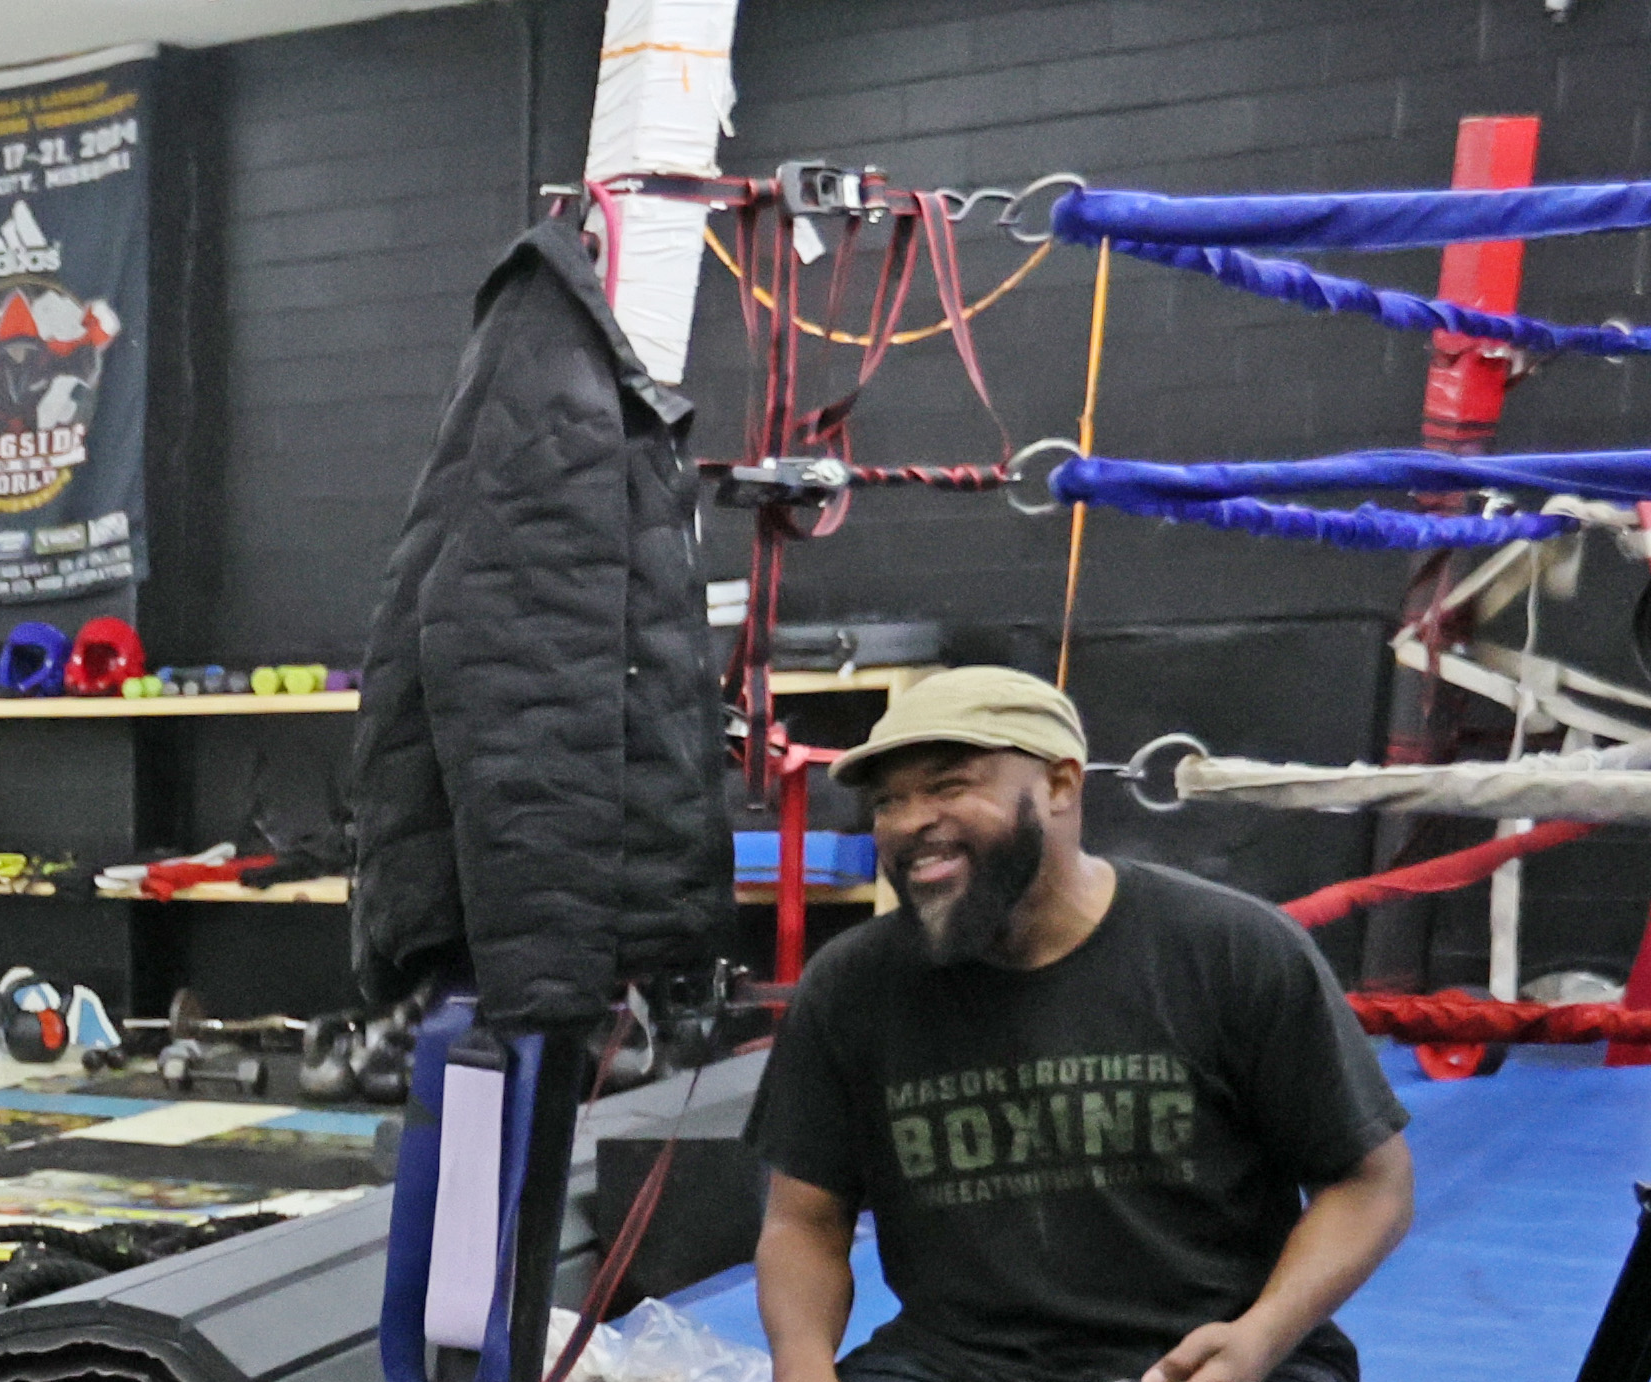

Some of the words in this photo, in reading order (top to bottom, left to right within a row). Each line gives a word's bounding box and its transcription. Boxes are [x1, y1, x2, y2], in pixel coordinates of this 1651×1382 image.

[887, 1068, 1008, 1110] MASON
[1017, 1054, 1189, 1090] BROTHERS
[891, 1090, 1196, 1179] BOXING
